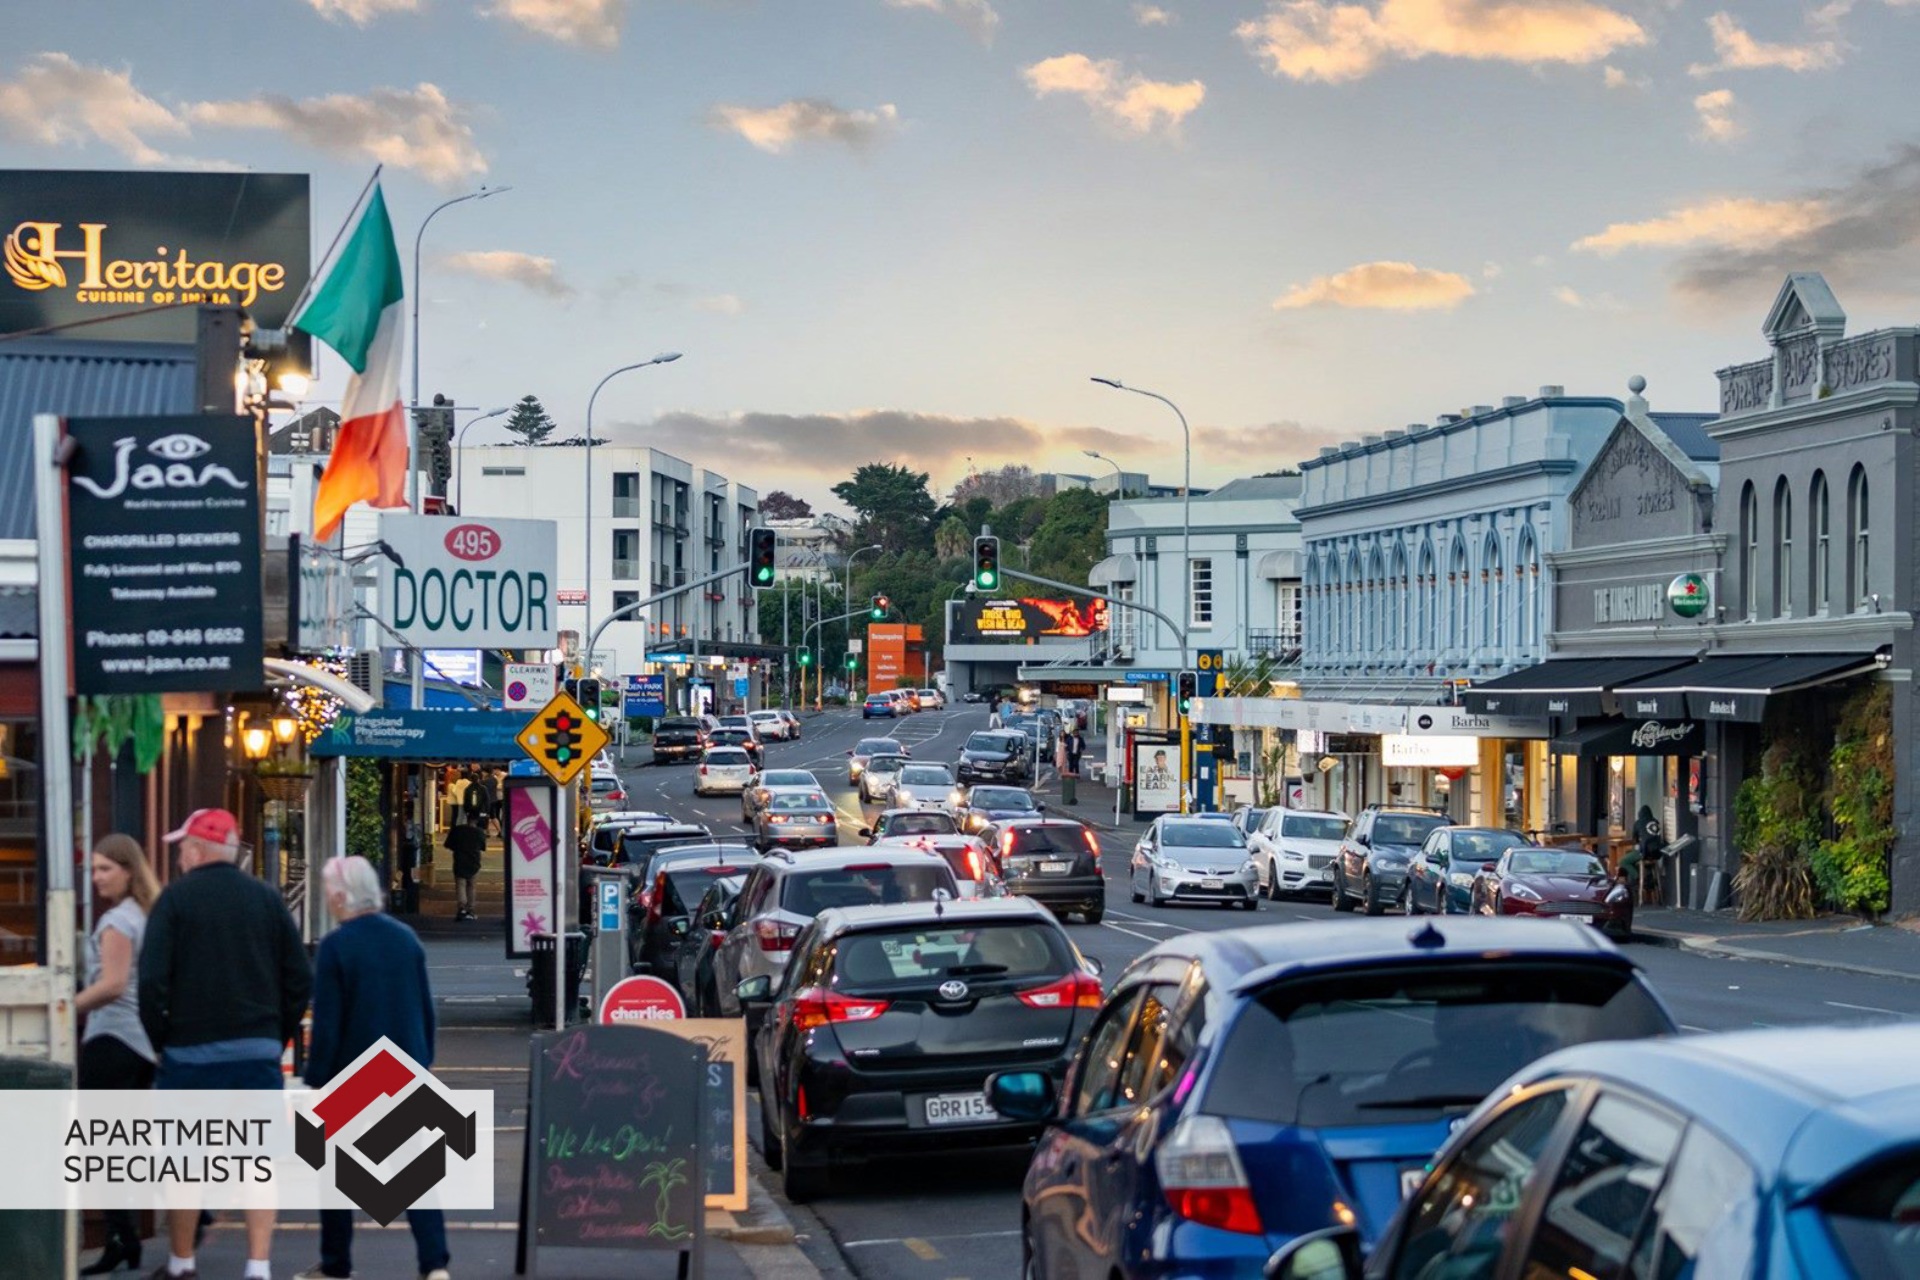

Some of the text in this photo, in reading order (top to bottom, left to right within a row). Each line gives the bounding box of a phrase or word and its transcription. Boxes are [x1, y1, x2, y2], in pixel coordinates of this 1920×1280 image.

[8, 221, 285, 306] Heritage
[77, 290, 230, 304] CUISINE OF INIA
[452, 530, 493, 556] 495
[394, 568, 547, 632] DOCTOR
[86, 630, 145, 647] Phone:
[355, 717, 403, 728] Kingsland
[1452, 714, 1490, 727] Barba
[355, 726, 426, 738] Physiotherapy
[604, 884, 618, 902] P
[611, 1005, 675, 1020] charlies
